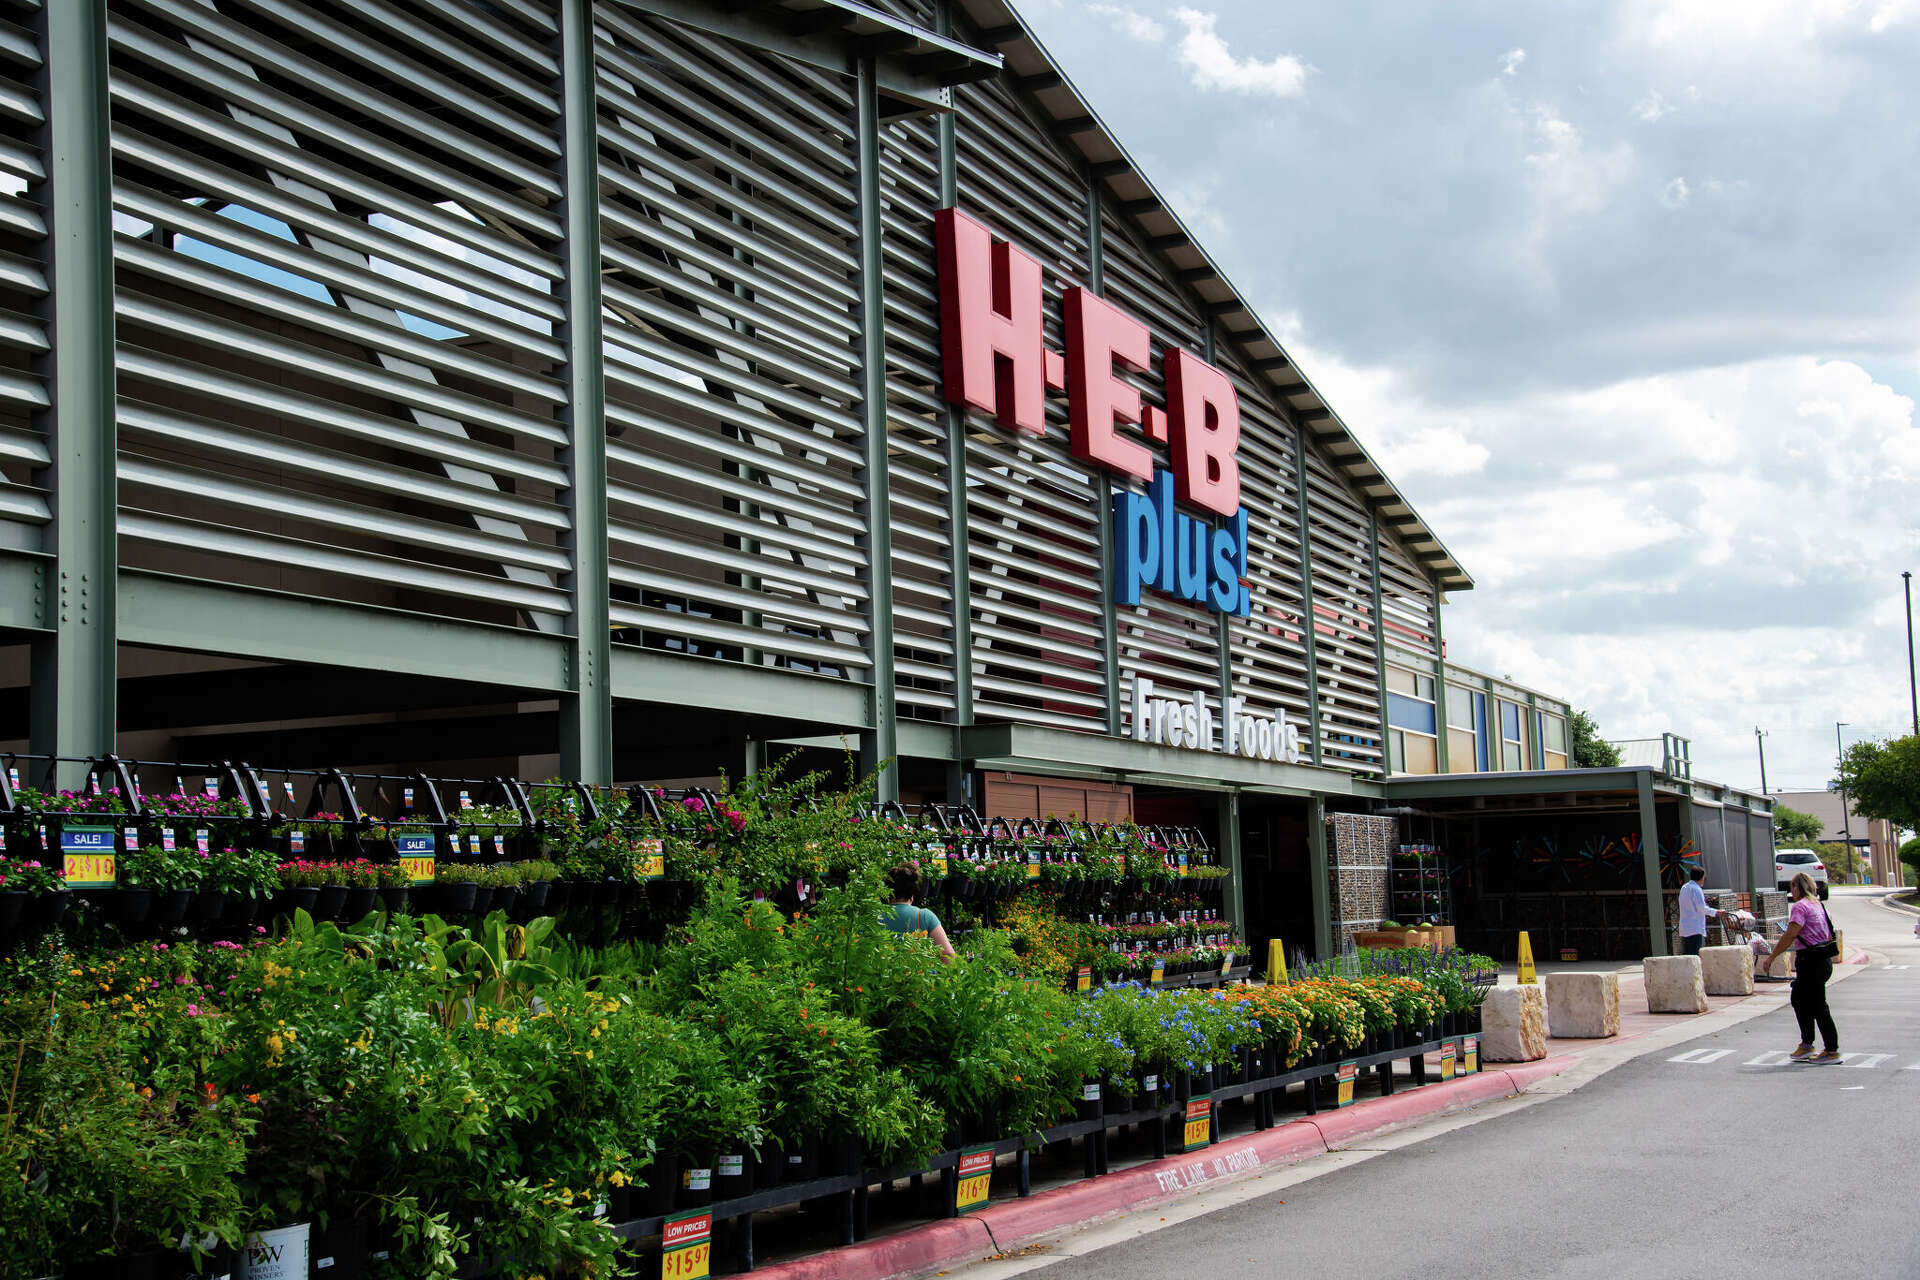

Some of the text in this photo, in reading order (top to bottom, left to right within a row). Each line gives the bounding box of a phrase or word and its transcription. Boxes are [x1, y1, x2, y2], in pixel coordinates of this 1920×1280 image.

[1114, 470, 1250, 617] plus!
[1132, 678, 1299, 763] Fresh Foods
[73, 834, 101, 845] SALE!
[407, 841, 426, 849] SALE!
[1155, 1146, 1260, 1192] FIRE LANE NO PARKING
[667, 1220, 707, 1237] LOW PRICES
[249, 1264, 281, 1274] PROVEN
